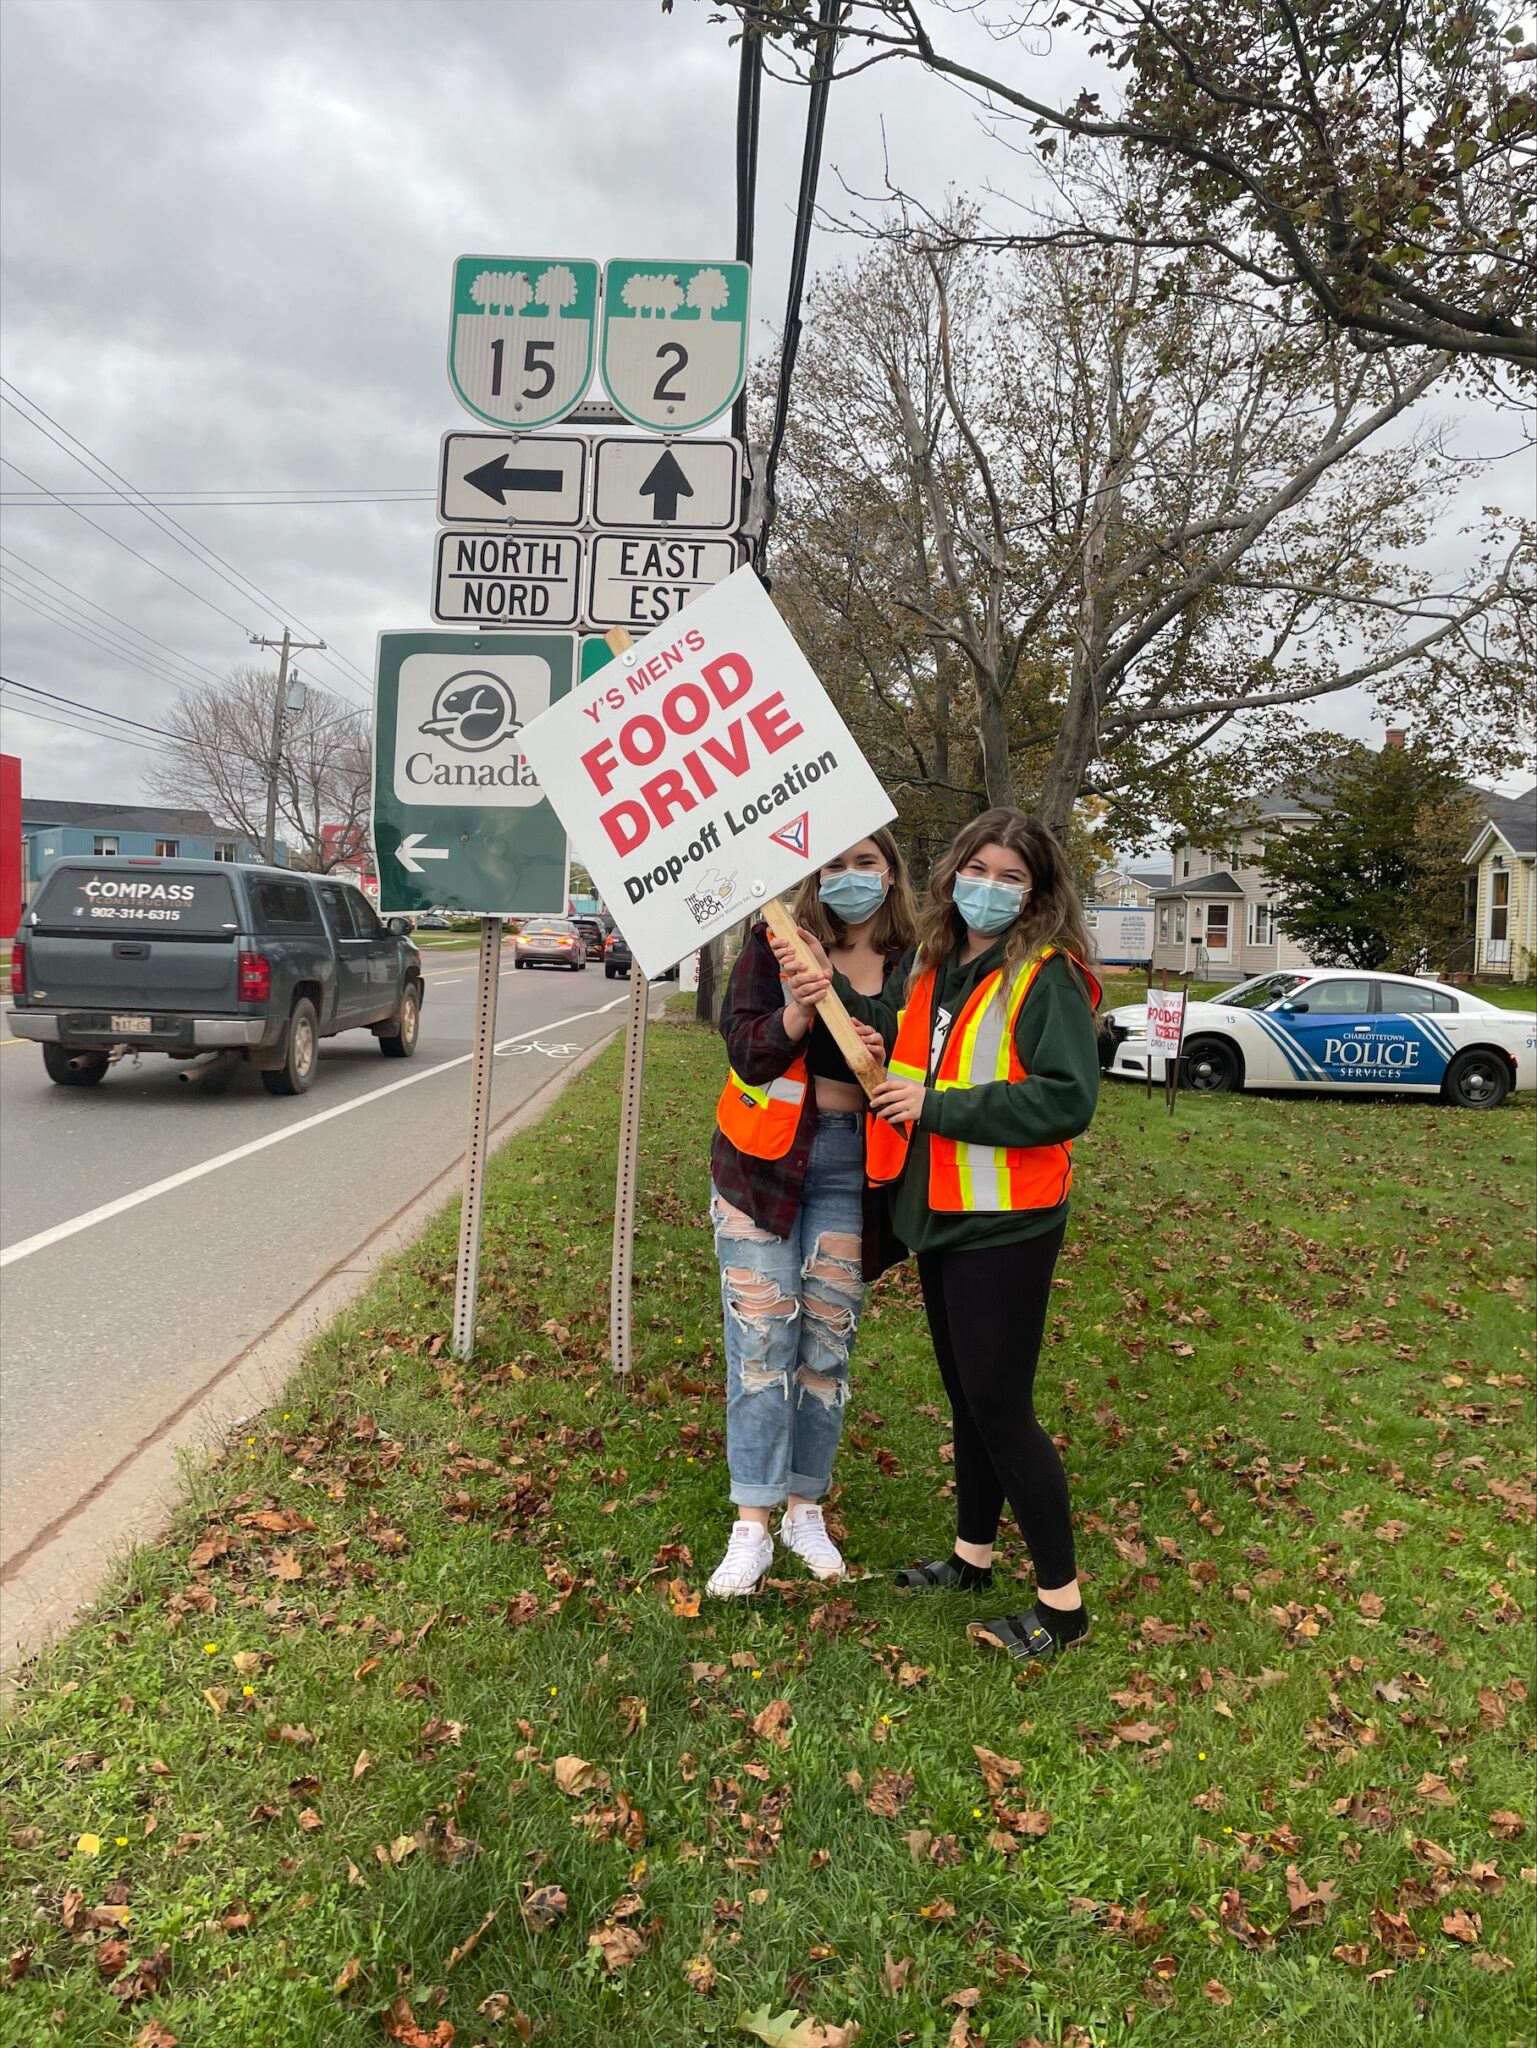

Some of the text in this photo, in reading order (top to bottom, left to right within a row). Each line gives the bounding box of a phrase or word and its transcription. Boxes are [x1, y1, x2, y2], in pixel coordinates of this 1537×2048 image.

[491, 339, 555, 399] 15
[653, 342, 688, 401] 2
[457, 540, 561, 575] NORTH
[620, 542, 705, 579] EAST
[463, 582, 549, 616] NORD
[630, 585, 690, 620] EST
[583, 629, 705, 724] Y'S MEN'S
[580, 652, 753, 797] FOOD
[405, 752, 540, 787] Canada
[599, 690, 805, 858] DRIVE
[623, 750, 839, 905] Drop-off Location
[85, 881, 195, 900] COMPASS
[95, 897, 192, 908] CONSTRUCTION
[684, 893, 699, 907] THE
[690, 895, 715, 916] UPPER
[90, 907, 180, 921] 902-314-6315
[694, 900, 724, 924] ROOM
[1226, 1016, 1236, 1024] 15
[1343, 1032, 1404, 1041] CHARLOTTETOWN
[1323, 1038, 1420, 1066] POLICE
[1340, 1067, 1402, 1078] SERVICES
